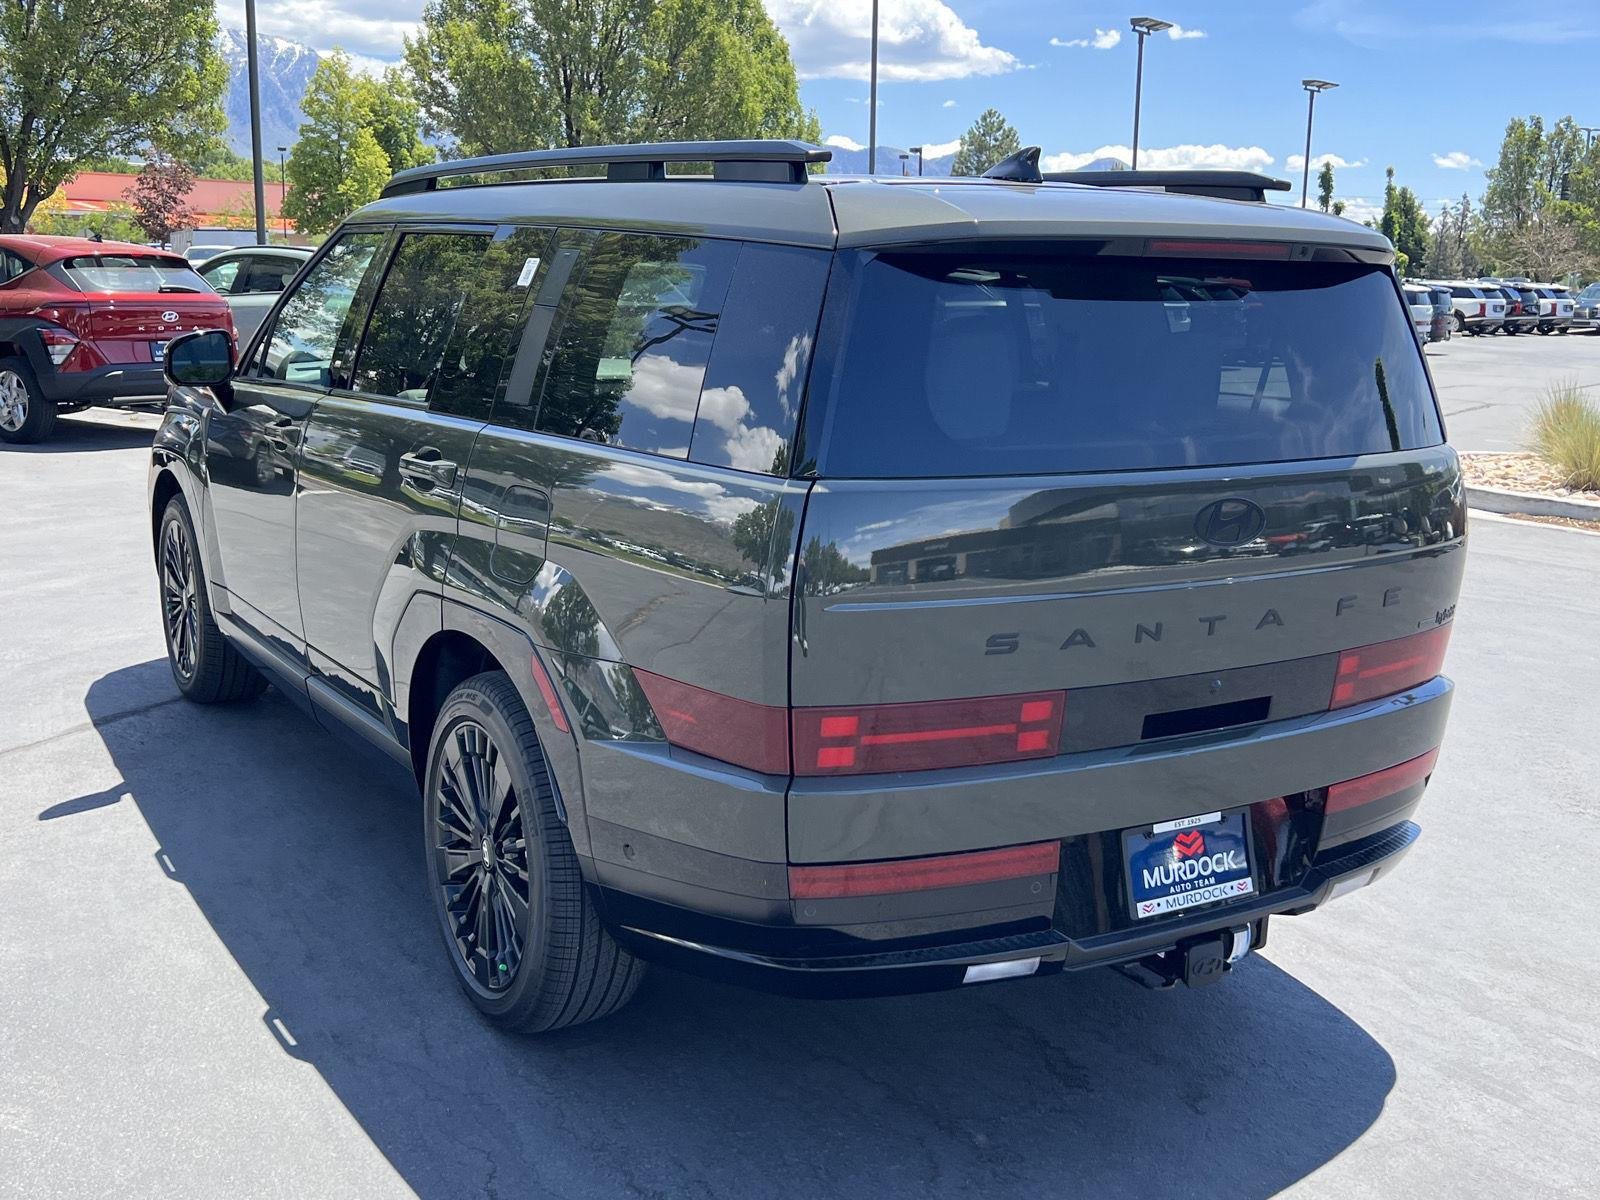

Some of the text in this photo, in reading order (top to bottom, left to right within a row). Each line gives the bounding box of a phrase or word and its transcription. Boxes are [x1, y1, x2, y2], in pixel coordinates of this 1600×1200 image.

[984, 585, 1403, 656] SANTA FE
[1142, 849, 1238, 889] MURDOCK
[1169, 876, 1216, 894] AUTO TEAM
[1165, 885, 1229, 909] MURDOCK
